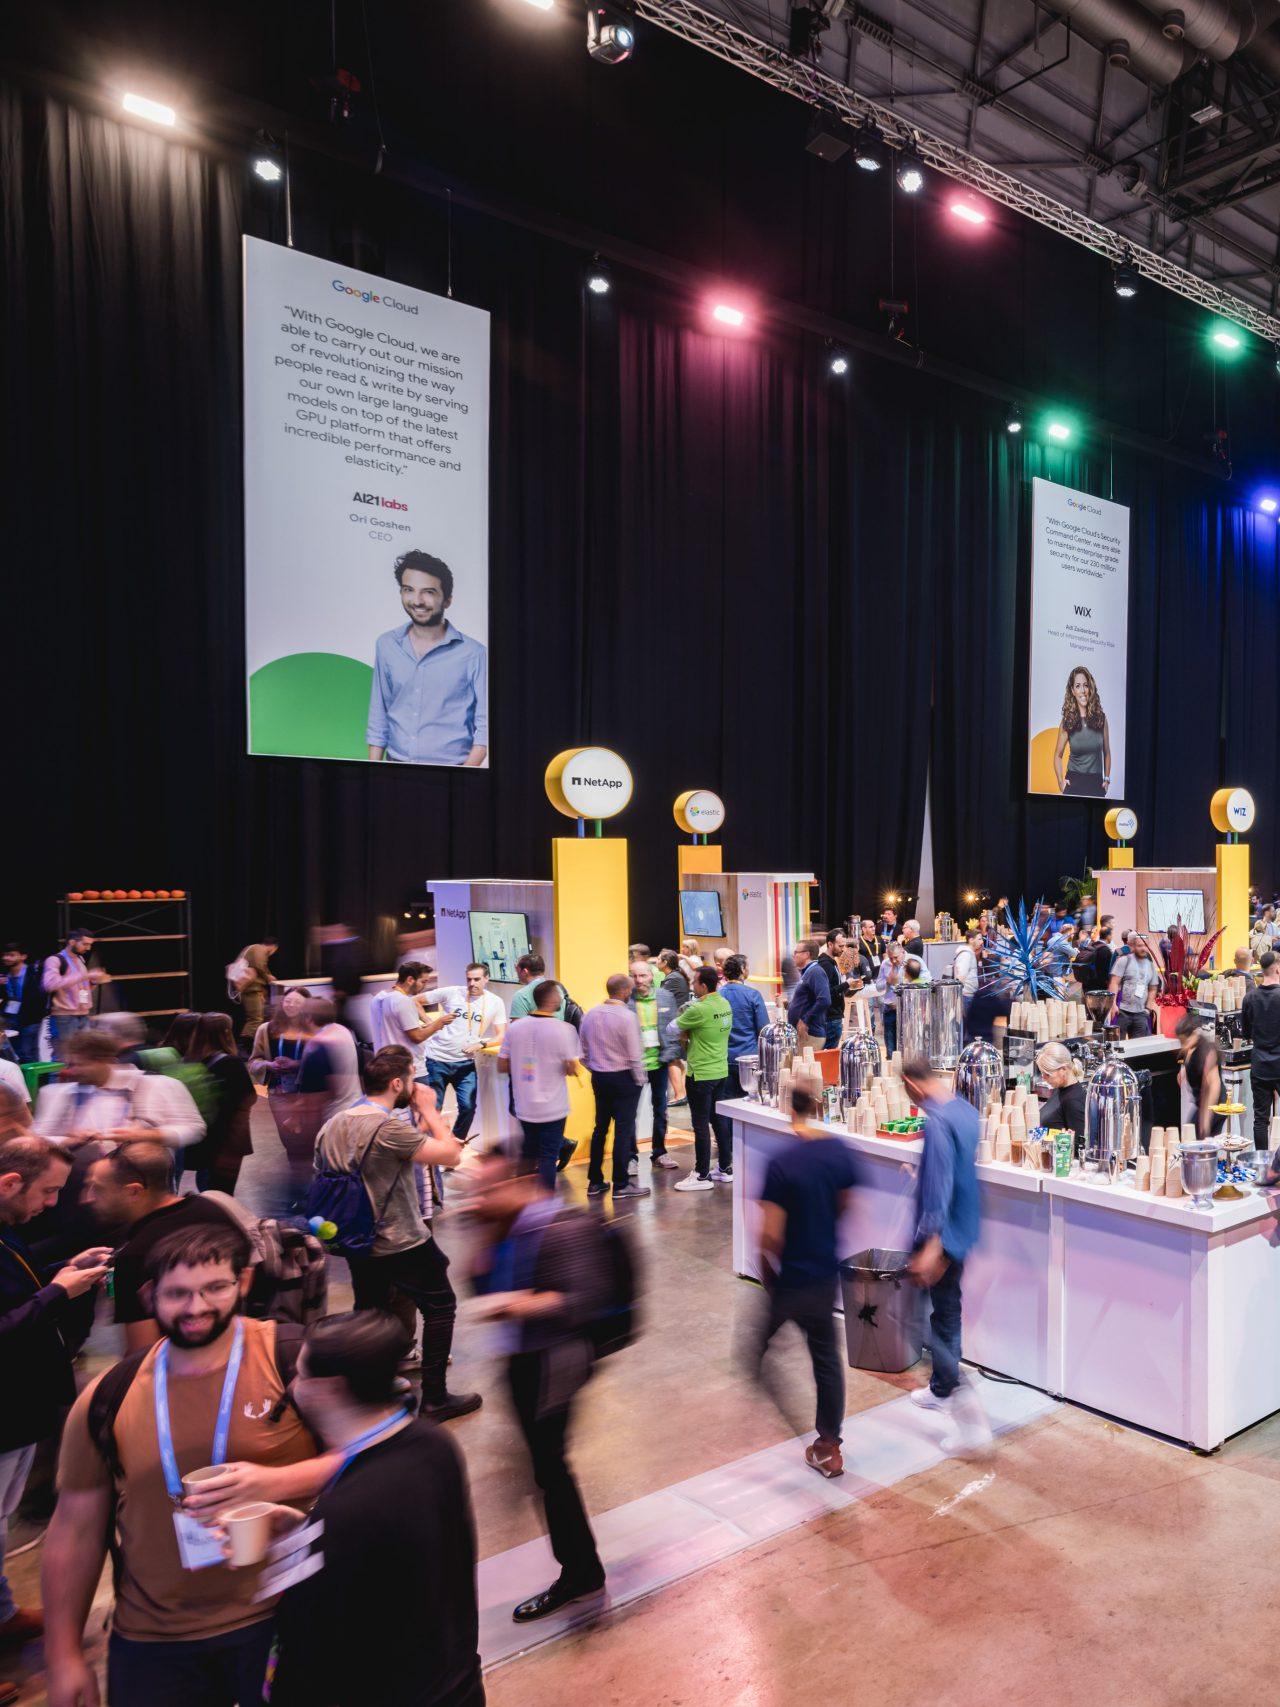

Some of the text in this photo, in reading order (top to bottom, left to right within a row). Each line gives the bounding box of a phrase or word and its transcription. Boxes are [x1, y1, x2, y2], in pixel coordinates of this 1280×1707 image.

[332, 280, 419, 315] Google Cloud
[281, 322, 463, 380] able to carry out our mission
[326, 317, 374, 340] Google
[421, 346, 439, 358] we
[442, 351, 460, 364] are
[291, 343, 455, 395] of revolutionizing the way
[275, 356, 468, 414] people read & write by serving
[300, 377, 448, 423] our own large language
[288, 390, 458, 440] models on top of the latest
[296, 410, 452, 454] GPU platform that offers
[285, 423, 461, 471] incredible performance and
[381, 497, 408, 512] labs
[1087, 505, 1102, 515] Cloud
[349, 513, 411, 532] Ori Goshen
[1062, 521, 1081, 533] Google
[1101, 533, 1121, 546] Security
[368, 530, 392, 542] CEO
[1046, 527, 1073, 541] Command
[1050, 550, 1071, 561] security
[1054, 541, 1076, 551] maintain
[584, 777, 623, 789] NetApp
[1233, 807, 1247, 817] WIZ
[447, 909, 466, 919] NetApp
